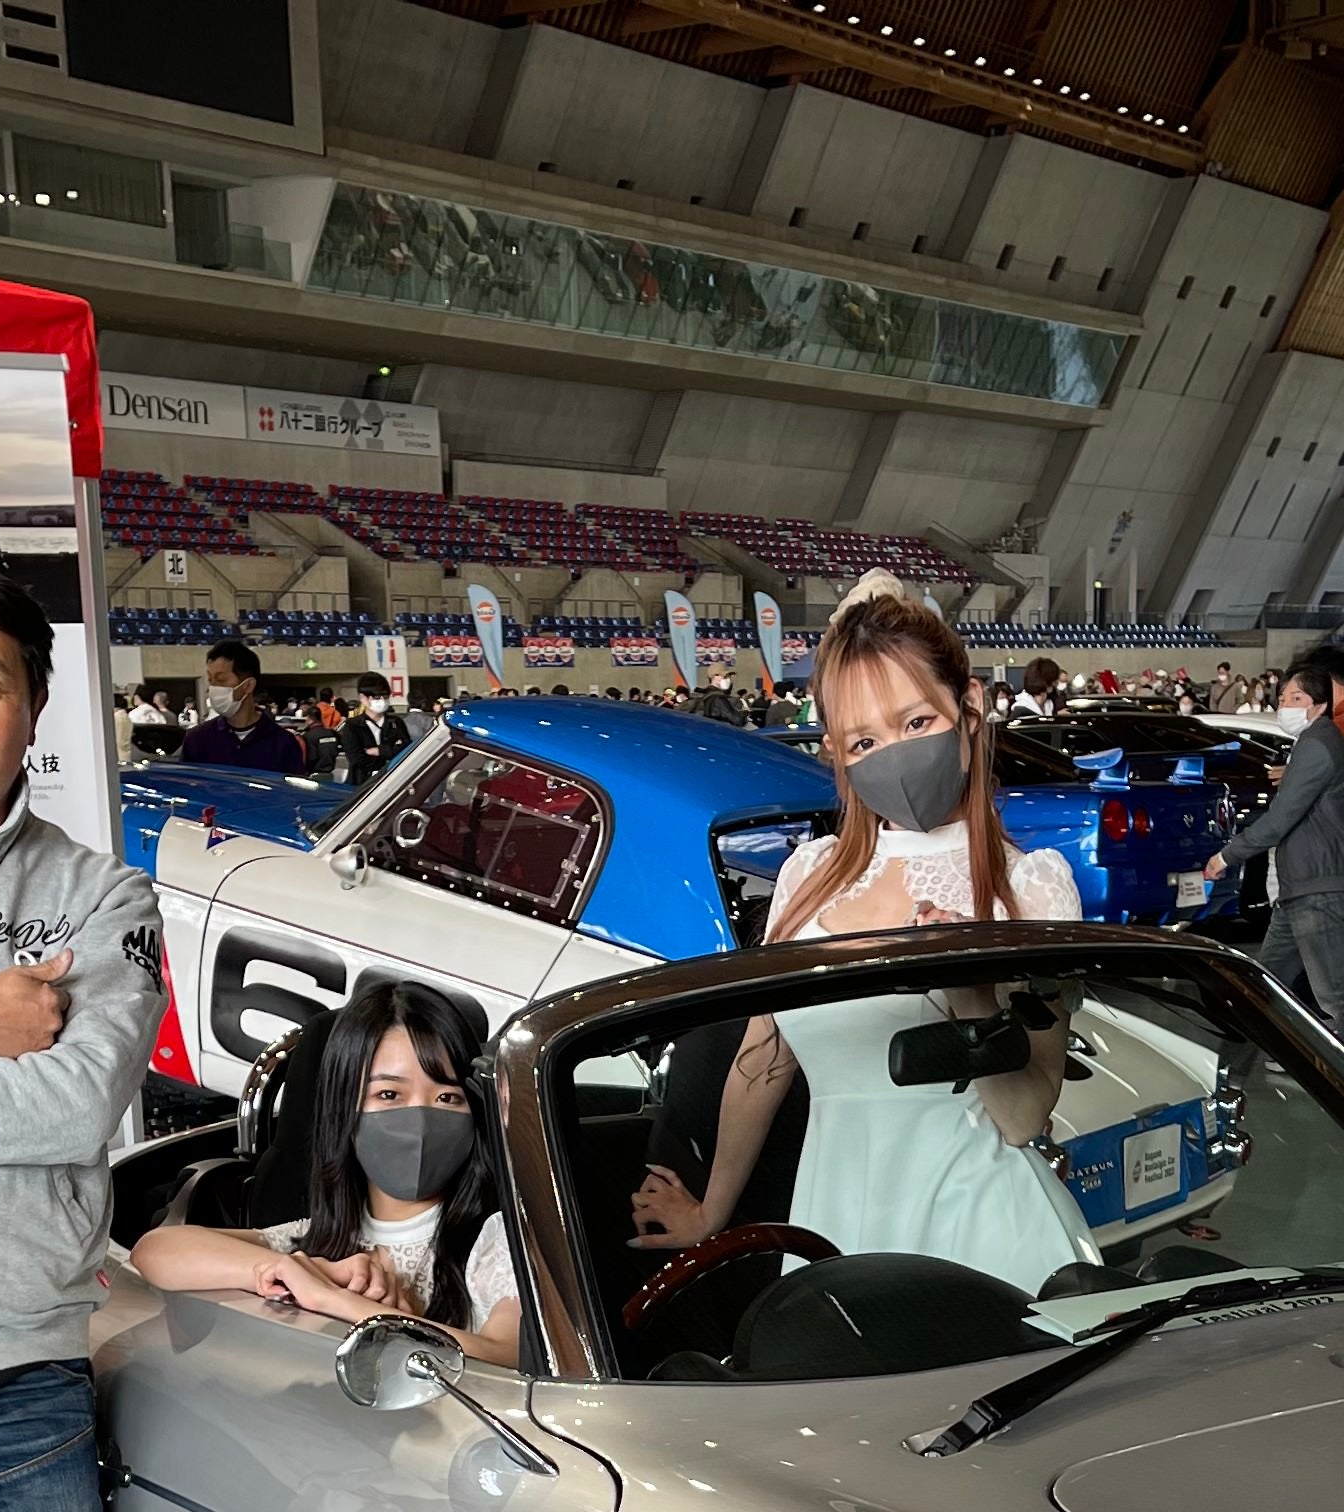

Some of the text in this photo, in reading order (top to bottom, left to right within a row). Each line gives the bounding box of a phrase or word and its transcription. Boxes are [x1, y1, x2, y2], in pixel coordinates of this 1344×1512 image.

[108, 384, 209, 425] Densan
[279, 411, 383, 438] 八十二銀行グループ
[167, 553, 184, 575] 北
[1066, 1160, 1115, 1180] DATSUN
